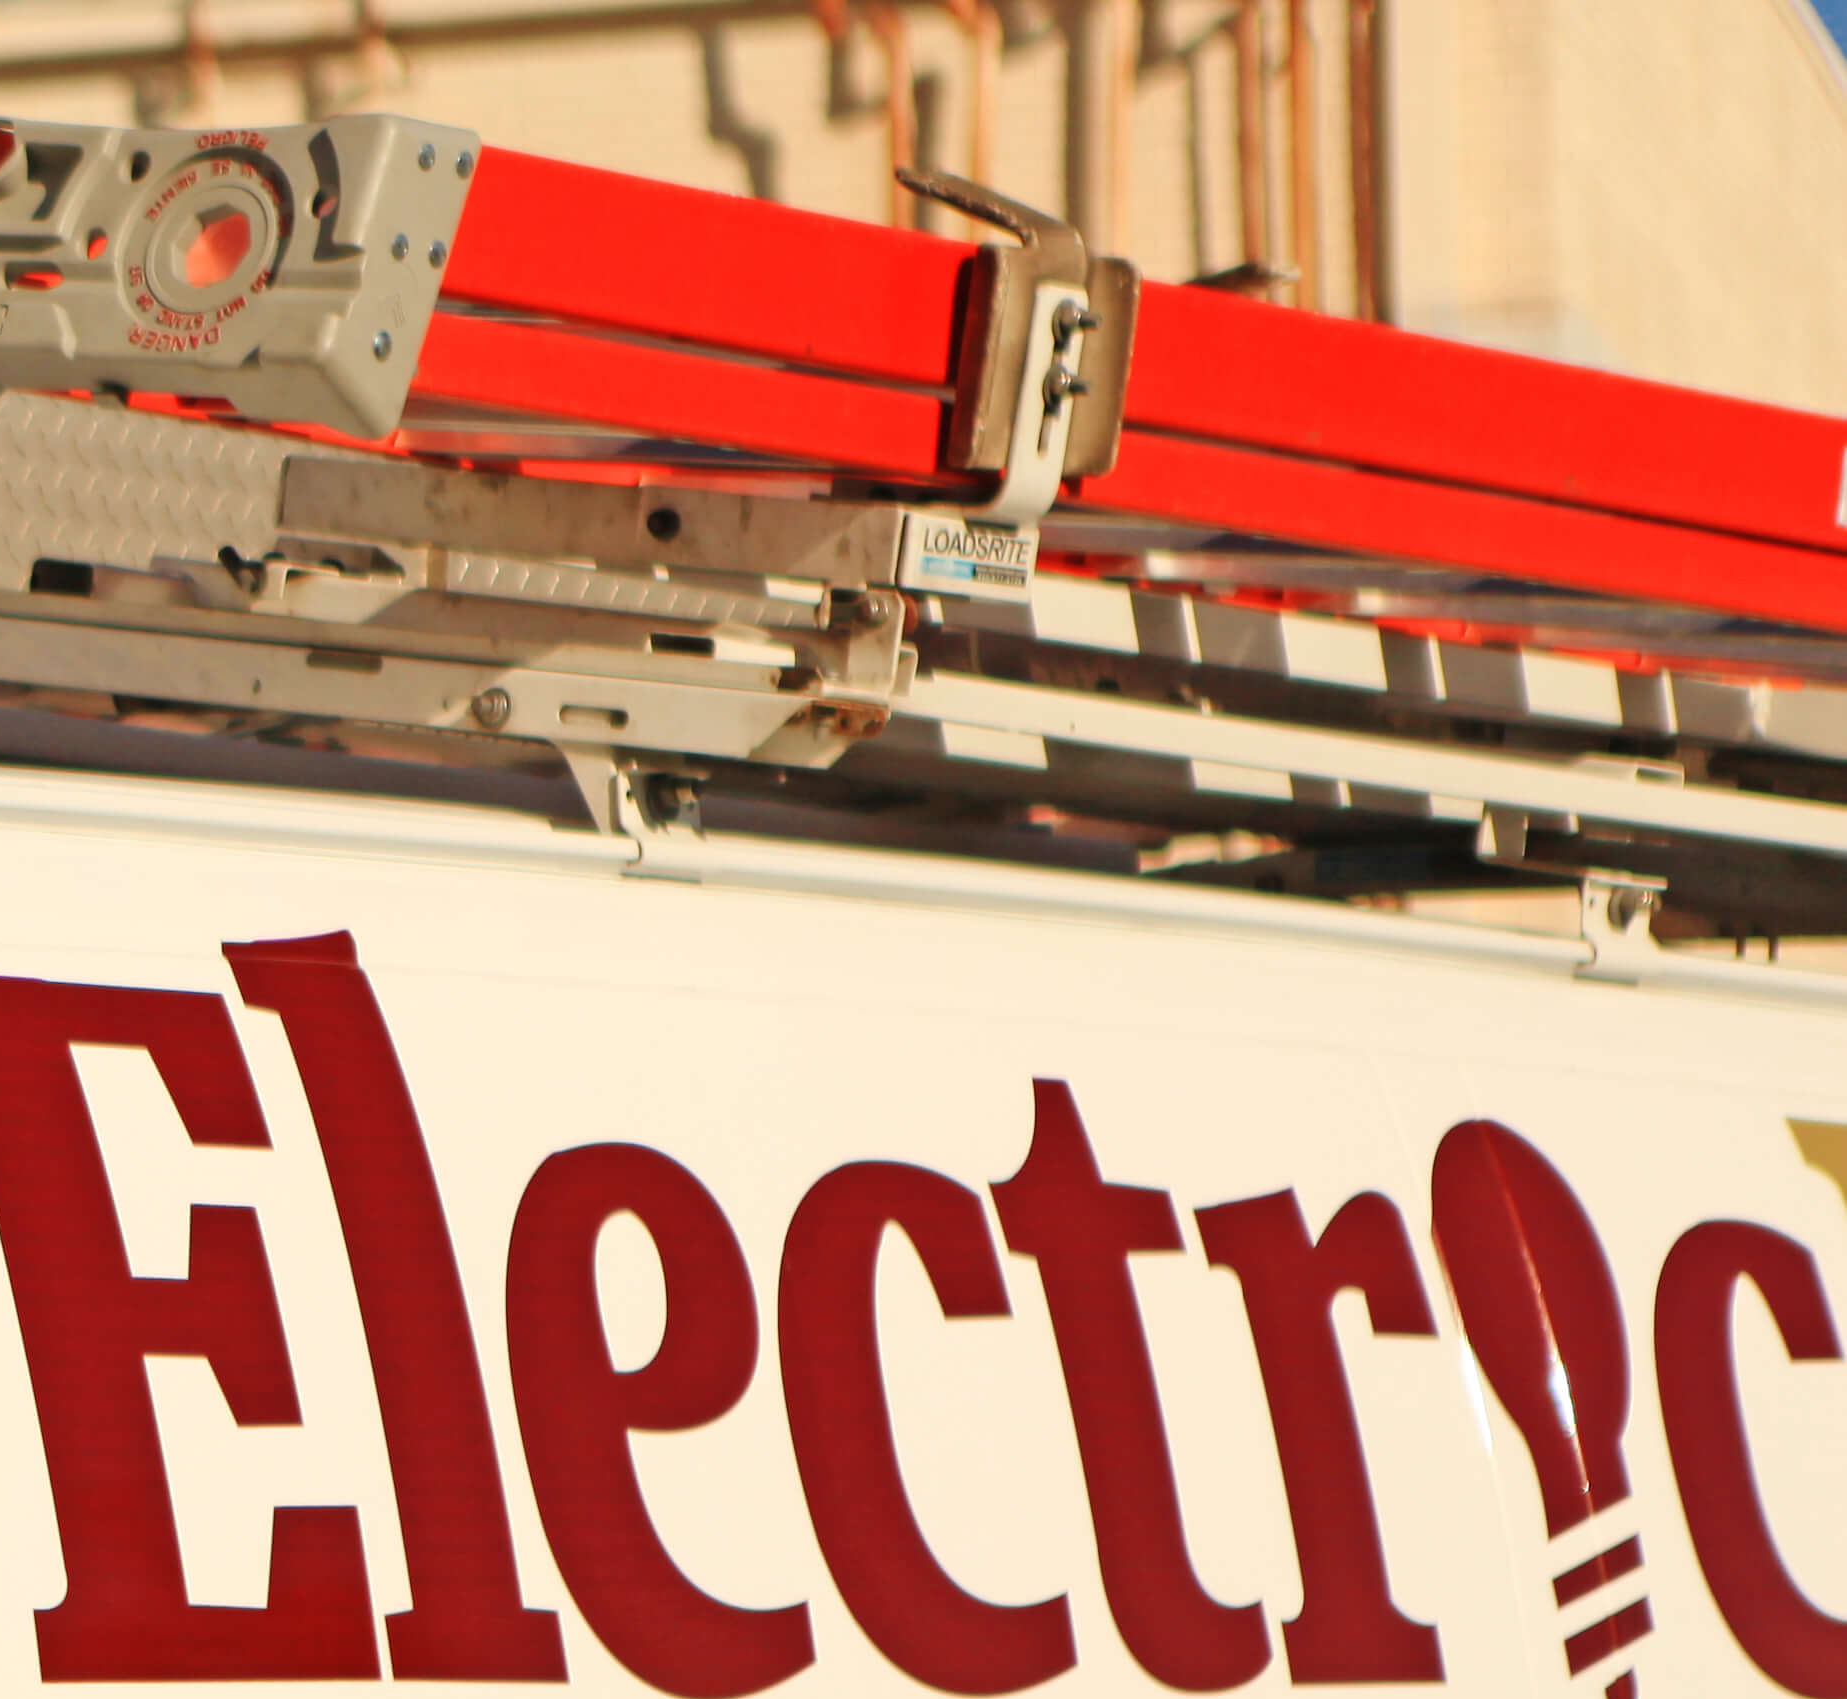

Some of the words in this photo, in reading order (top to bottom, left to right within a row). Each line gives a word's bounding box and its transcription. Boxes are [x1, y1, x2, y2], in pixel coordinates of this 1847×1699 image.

[156, 306, 205, 331] STAND
[128, 320, 222, 352] DANGER
[923, 527, 1032, 564] LOADSRITE
